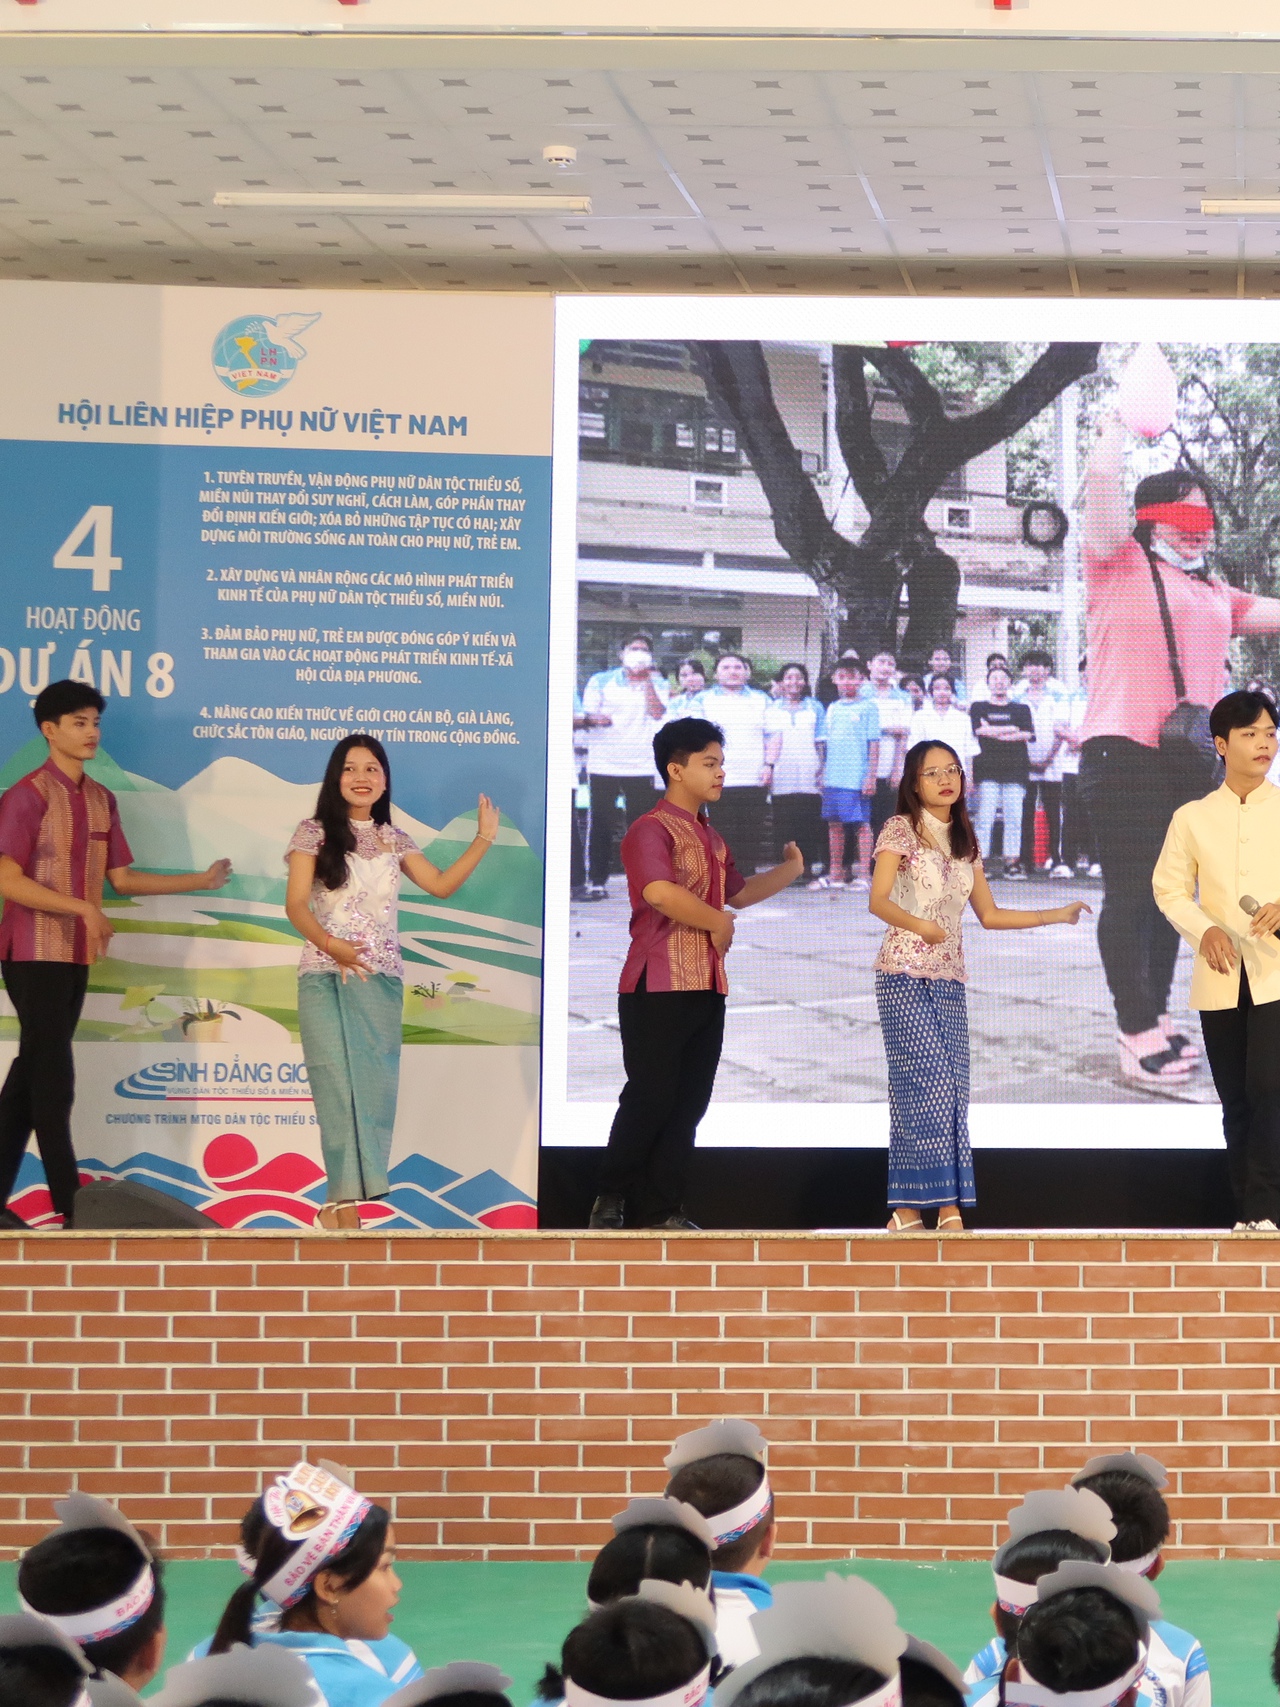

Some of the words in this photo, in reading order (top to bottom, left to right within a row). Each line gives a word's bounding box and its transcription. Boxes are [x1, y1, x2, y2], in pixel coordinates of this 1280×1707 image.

[256, 370, 277, 380] NAM
[58, 398, 102, 431] HỘI
[109, 400, 168, 428] LIÊN
[175, 403, 234, 435] HIỆP
[240, 409, 294, 438] PHỤ
[300, 406, 340, 432] NỮ
[343, 408, 402, 440] VIỆT
[408, 414, 468, 436] NAM
[204, 471, 214, 482] 1.
[217, 470, 254, 483] TUYÊN
[256, 470, 306, 489] TRUYỀN,
[308, 472, 332, 488] VẬN
[334, 472, 368, 489] ĐỘNG
[370, 476, 395, 490] PHỤ
[398, 474, 416, 488] NỮ
[418, 475, 442, 489] DÂN
[444, 476, 466, 492] TỘC
[468, 475, 502, 490] THIỂU
[504, 476, 522, 493] SỐ,
[202, 506, 223, 522] ĐỔI
[225, 510, 256, 525] ĐỊNH
[258, 508, 286, 523] KIẾN
[288, 510, 316, 526] GIỚI;
[319, 511, 342, 525] XÓA
[344, 510, 361, 525] BỎ
[363, 512, 406, 526] NHỮNG
[408, 513, 430, 530] TẬP
[432, 516, 454, 531] TỤC
[456, 515, 470, 528] CÓ
[474, 517, 497, 532] HẠI;
[500, 516, 521, 530] XÂY
[53, 505, 123, 592] 4
[201, 528, 235, 544] DỰNG
[238, 528, 260, 542] MÔI
[263, 529, 311, 543] TRƯỜNG
[314, 529, 345, 544] SỐNG
[348, 533, 364, 545] AN
[367, 532, 397, 546] TOÀN
[400, 535, 424, 546] CHO
[426, 536, 450, 550] PHỤ
[453, 534, 474, 550] NỮ,
[476, 534, 497, 548] TRẺ
[500, 537, 520, 549] EM.
[206, 569, 218, 580] 2.
[220, 567, 242, 581] XÂY
[244, 568, 278, 586] DỰNG
[280, 568, 296, 582] VÀ
[298, 569, 332, 583] NHÂN
[335, 570, 367, 587] RỘNG
[370, 571, 391, 584] CÁC
[394, 572, 412, 585] MÔ
[415, 572, 445, 586] HÌNH
[448, 573, 477, 587] PHÁT
[479, 572, 513, 588] TRIỂN
[218, 588, 247, 600] KINH
[249, 586, 263, 601] TẾ
[265, 586, 288, 601] CỦA
[291, 590, 316, 605] PHỤ
[319, 589, 336, 602] NỮ
[339, 590, 363, 603] DÂN
[366, 590, 387, 607] TỘC
[389, 590, 423, 605] THIỂU
[426, 591, 444, 607] SỐ,
[446, 591, 476, 606] MIỀN
[480, 593, 504, 607] NÚI.
[26, 606, 79, 634] HOẠT
[82, 604, 142, 636] ĐỘNG
[203, 647, 237, 659] THAM
[240, 648, 260, 660] GIA
[262, 646, 286, 660] VÀO
[288, 647, 310, 660] CÁC
[312, 649, 342, 664] HOẠT
[344, 648, 378, 665] ĐỘNG
[381, 649, 411, 663] PHÁT
[413, 648, 446, 664] TRIỂN
[450, 653, 478, 665] KINH
[68, 638, 132, 697] ÁN
[145, 652, 176, 699] 8
[296, 667, 316, 683] HỘI
[319, 666, 342, 681] CỦA
[344, 670, 365, 684] ĐỊA
[368, 670, 421, 683] PHƯƠNG.
[200, 706, 211, 717] 4.
[214, 704, 247, 720] NÂNG
[250, 707, 273, 719] CAO
[276, 704, 302, 719] KIẾN
[305, 706, 336, 720] THỨC
[356, 707, 380, 721] GIỚI
[382, 710, 406, 721] CHO
[408, 708, 432, 722] CÁN
[435, 709, 454, 726] BỘ,
[457, 710, 476, 723] GIÀ
[480, 710, 513, 726] LÀNG,
[154, 1058, 208, 1082] BÌNH
[213, 1054, 272, 1083] ĐẲNG
[190, 1114, 221, 1125] MTQG
[225, 1112, 246, 1124] DÂN
[250, 1112, 271, 1127] TỘC
[274, 1110, 306, 1125] THIỂU
